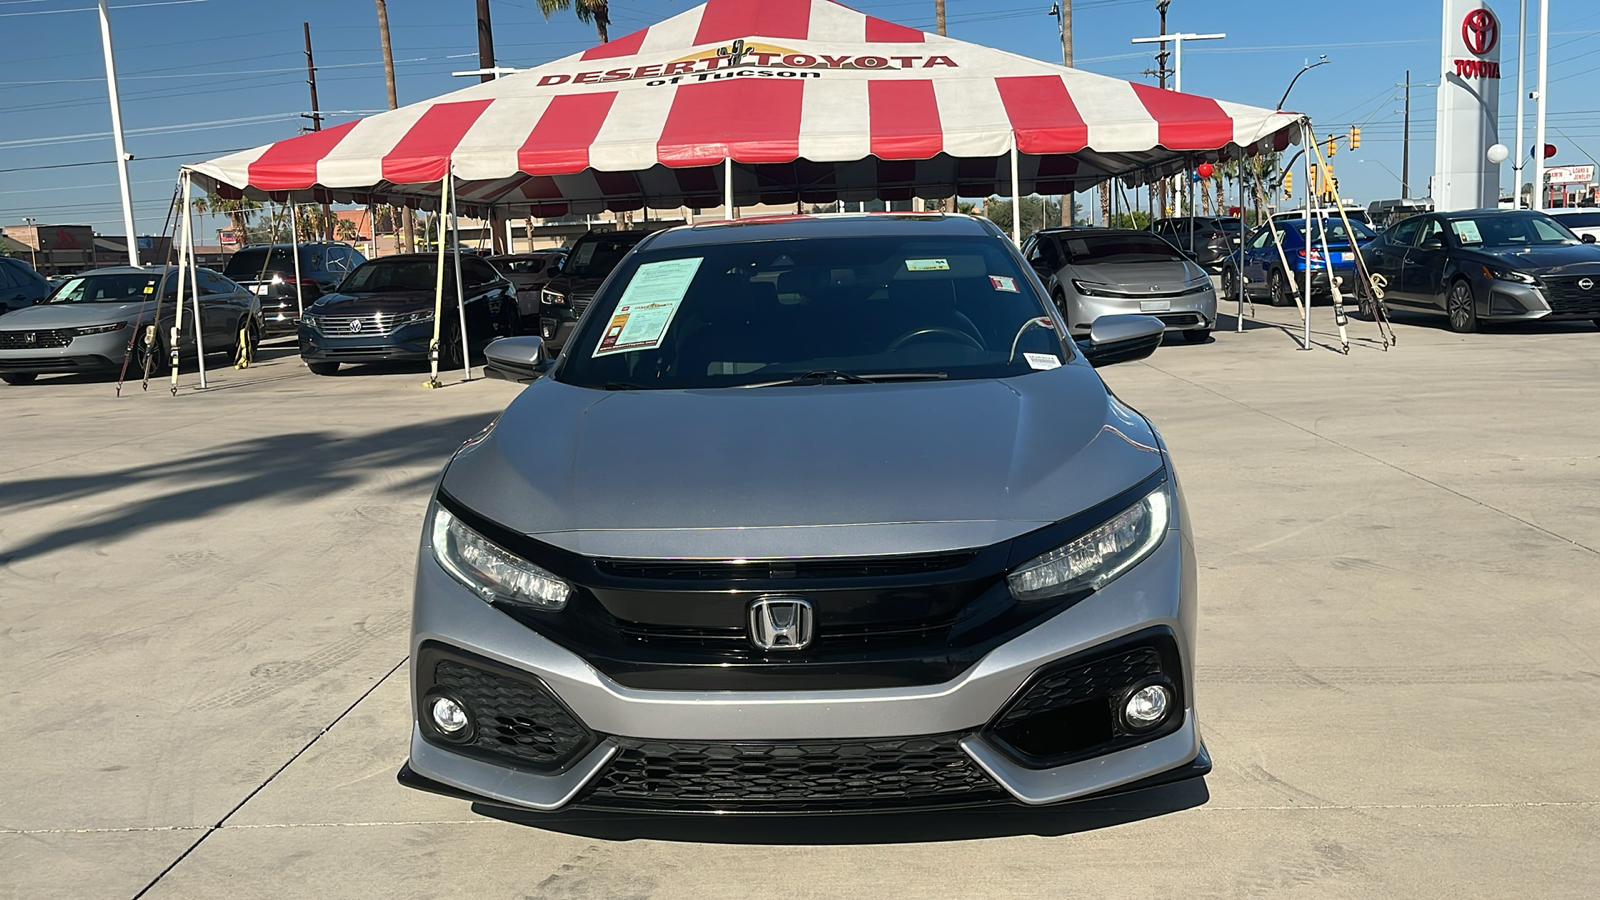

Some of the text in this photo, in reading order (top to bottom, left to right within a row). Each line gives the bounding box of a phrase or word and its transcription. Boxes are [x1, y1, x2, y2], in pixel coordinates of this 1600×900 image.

[536, 51, 959, 87] DESERT TOYOTA
[646, 70, 821, 86] of Tucson
[1454, 59, 1501, 79] TOYOTA
